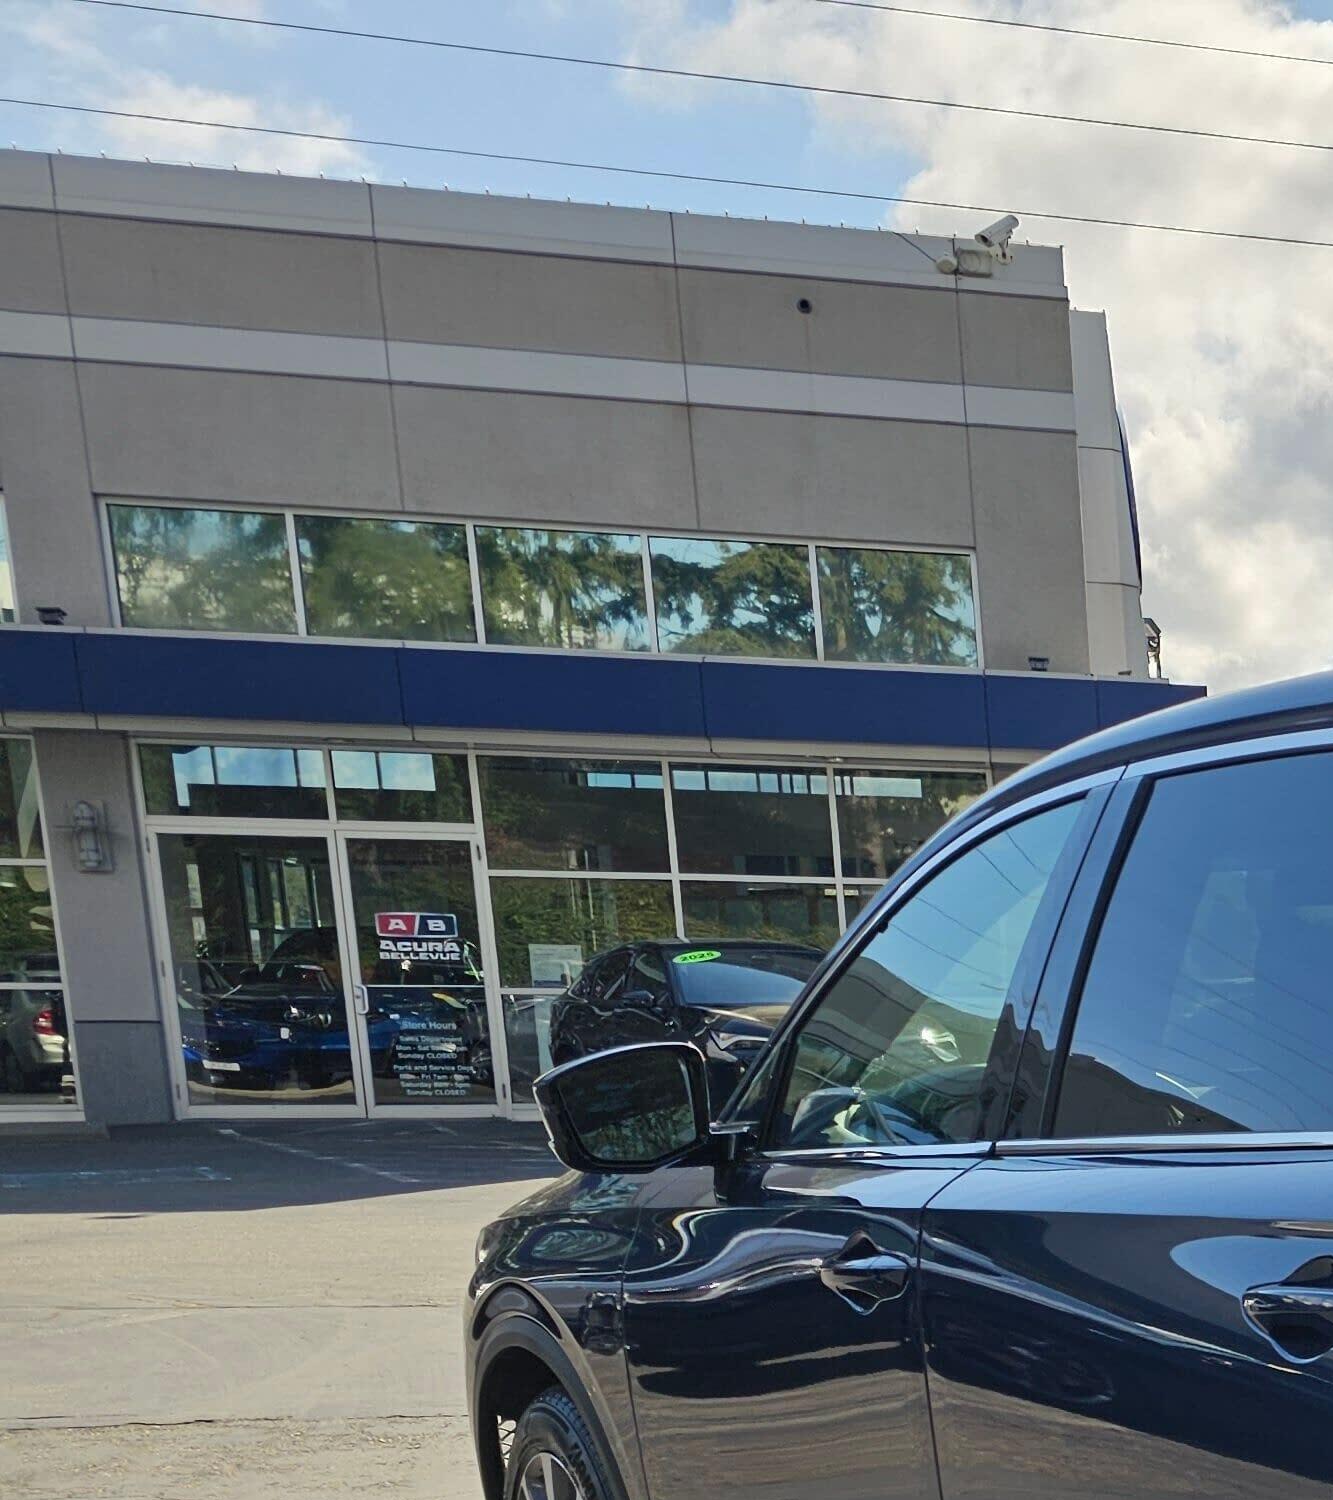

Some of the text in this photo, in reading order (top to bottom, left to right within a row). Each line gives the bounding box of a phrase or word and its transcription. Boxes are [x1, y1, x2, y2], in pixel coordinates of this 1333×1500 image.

[388, 919, 446, 931] A B
[380, 940, 460, 952] ACURA
[379, 951, 461, 960] BELLEVUE
[401, 1021, 457, 1030] Store Hours
